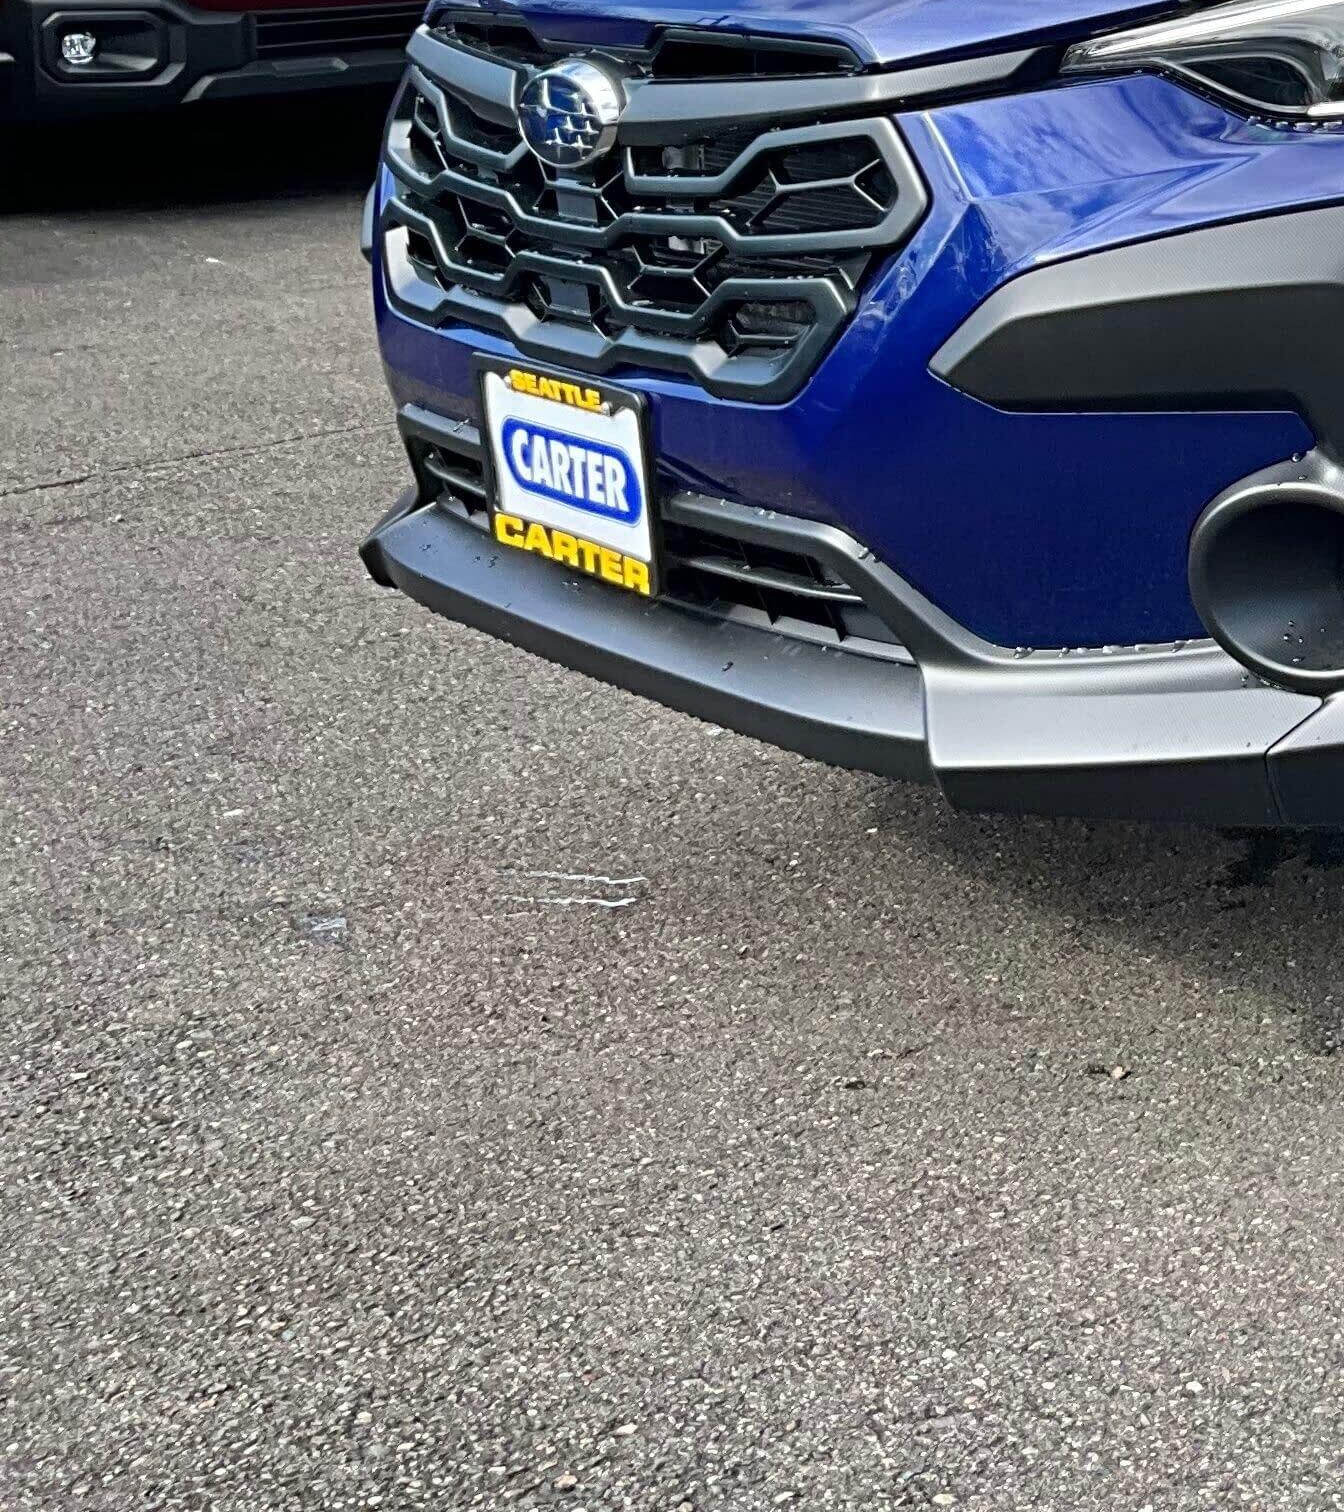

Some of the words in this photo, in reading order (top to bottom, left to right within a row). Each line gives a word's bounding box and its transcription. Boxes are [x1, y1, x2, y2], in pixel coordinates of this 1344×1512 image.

[510, 369, 602, 412] SEATTLE
[511, 428, 630, 513] CARTER
[494, 512, 651, 595] CARTER
